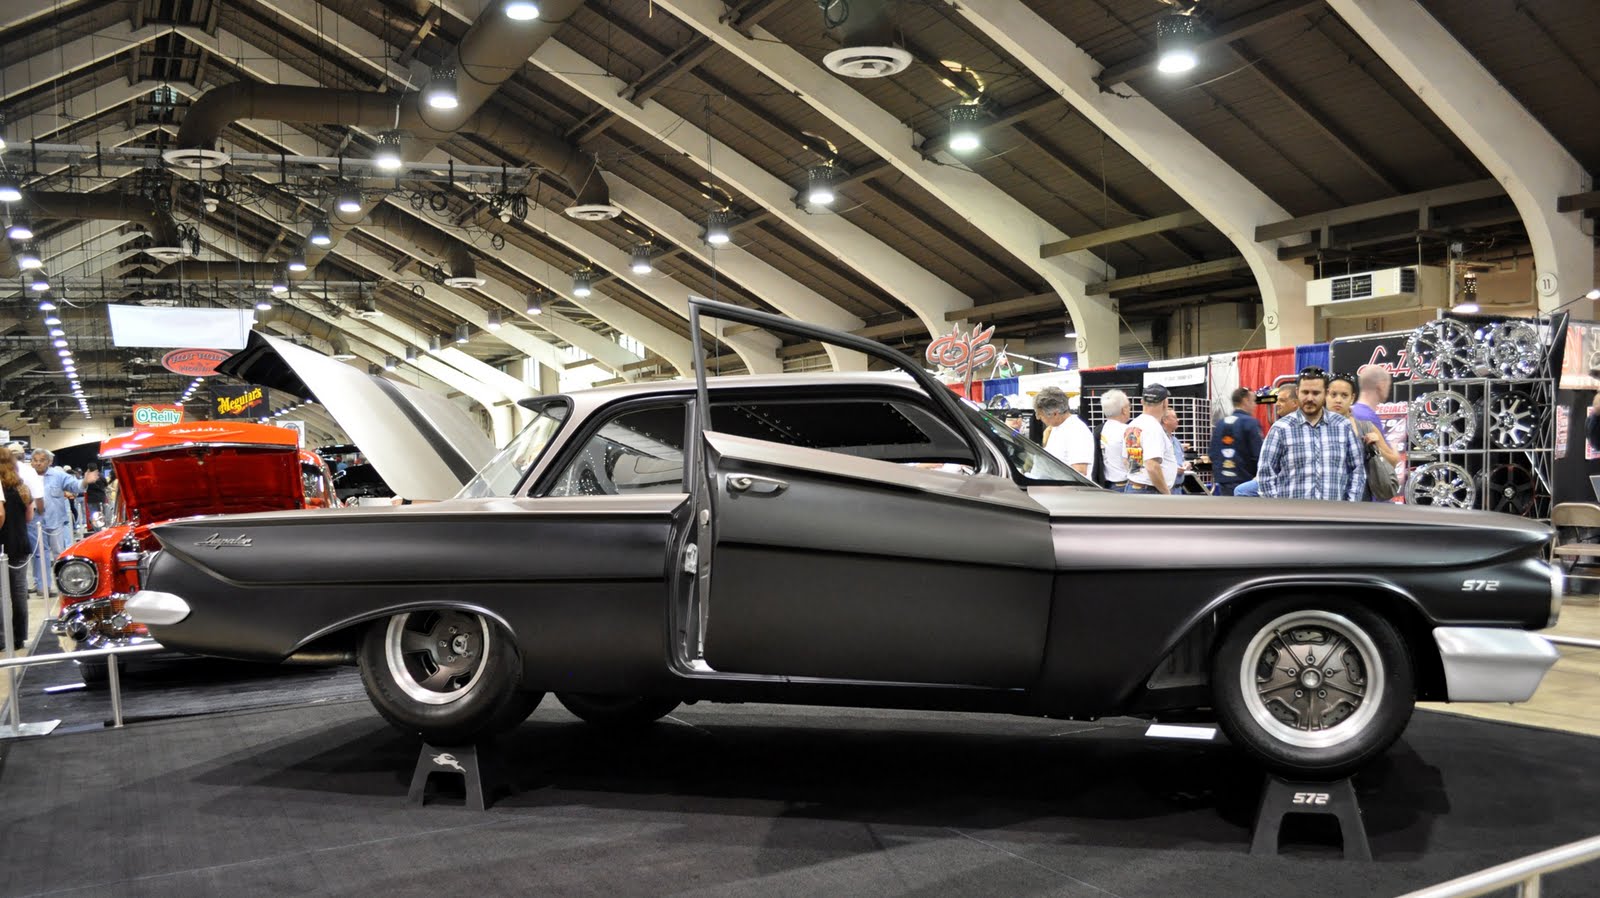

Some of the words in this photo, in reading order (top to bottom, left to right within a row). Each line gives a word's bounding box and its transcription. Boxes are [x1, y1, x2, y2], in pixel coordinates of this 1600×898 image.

[1543, 278, 1550, 290] 11
[1267, 315, 1274, 325] 12
[217, 387, 262, 415] Meguiar's
[1375, 404, 1407, 414] PECIALS
[137, 409, 180, 423] O'Reilly
[1461, 579, 1500, 591] 572
[1292, 792, 1330, 804] 572
